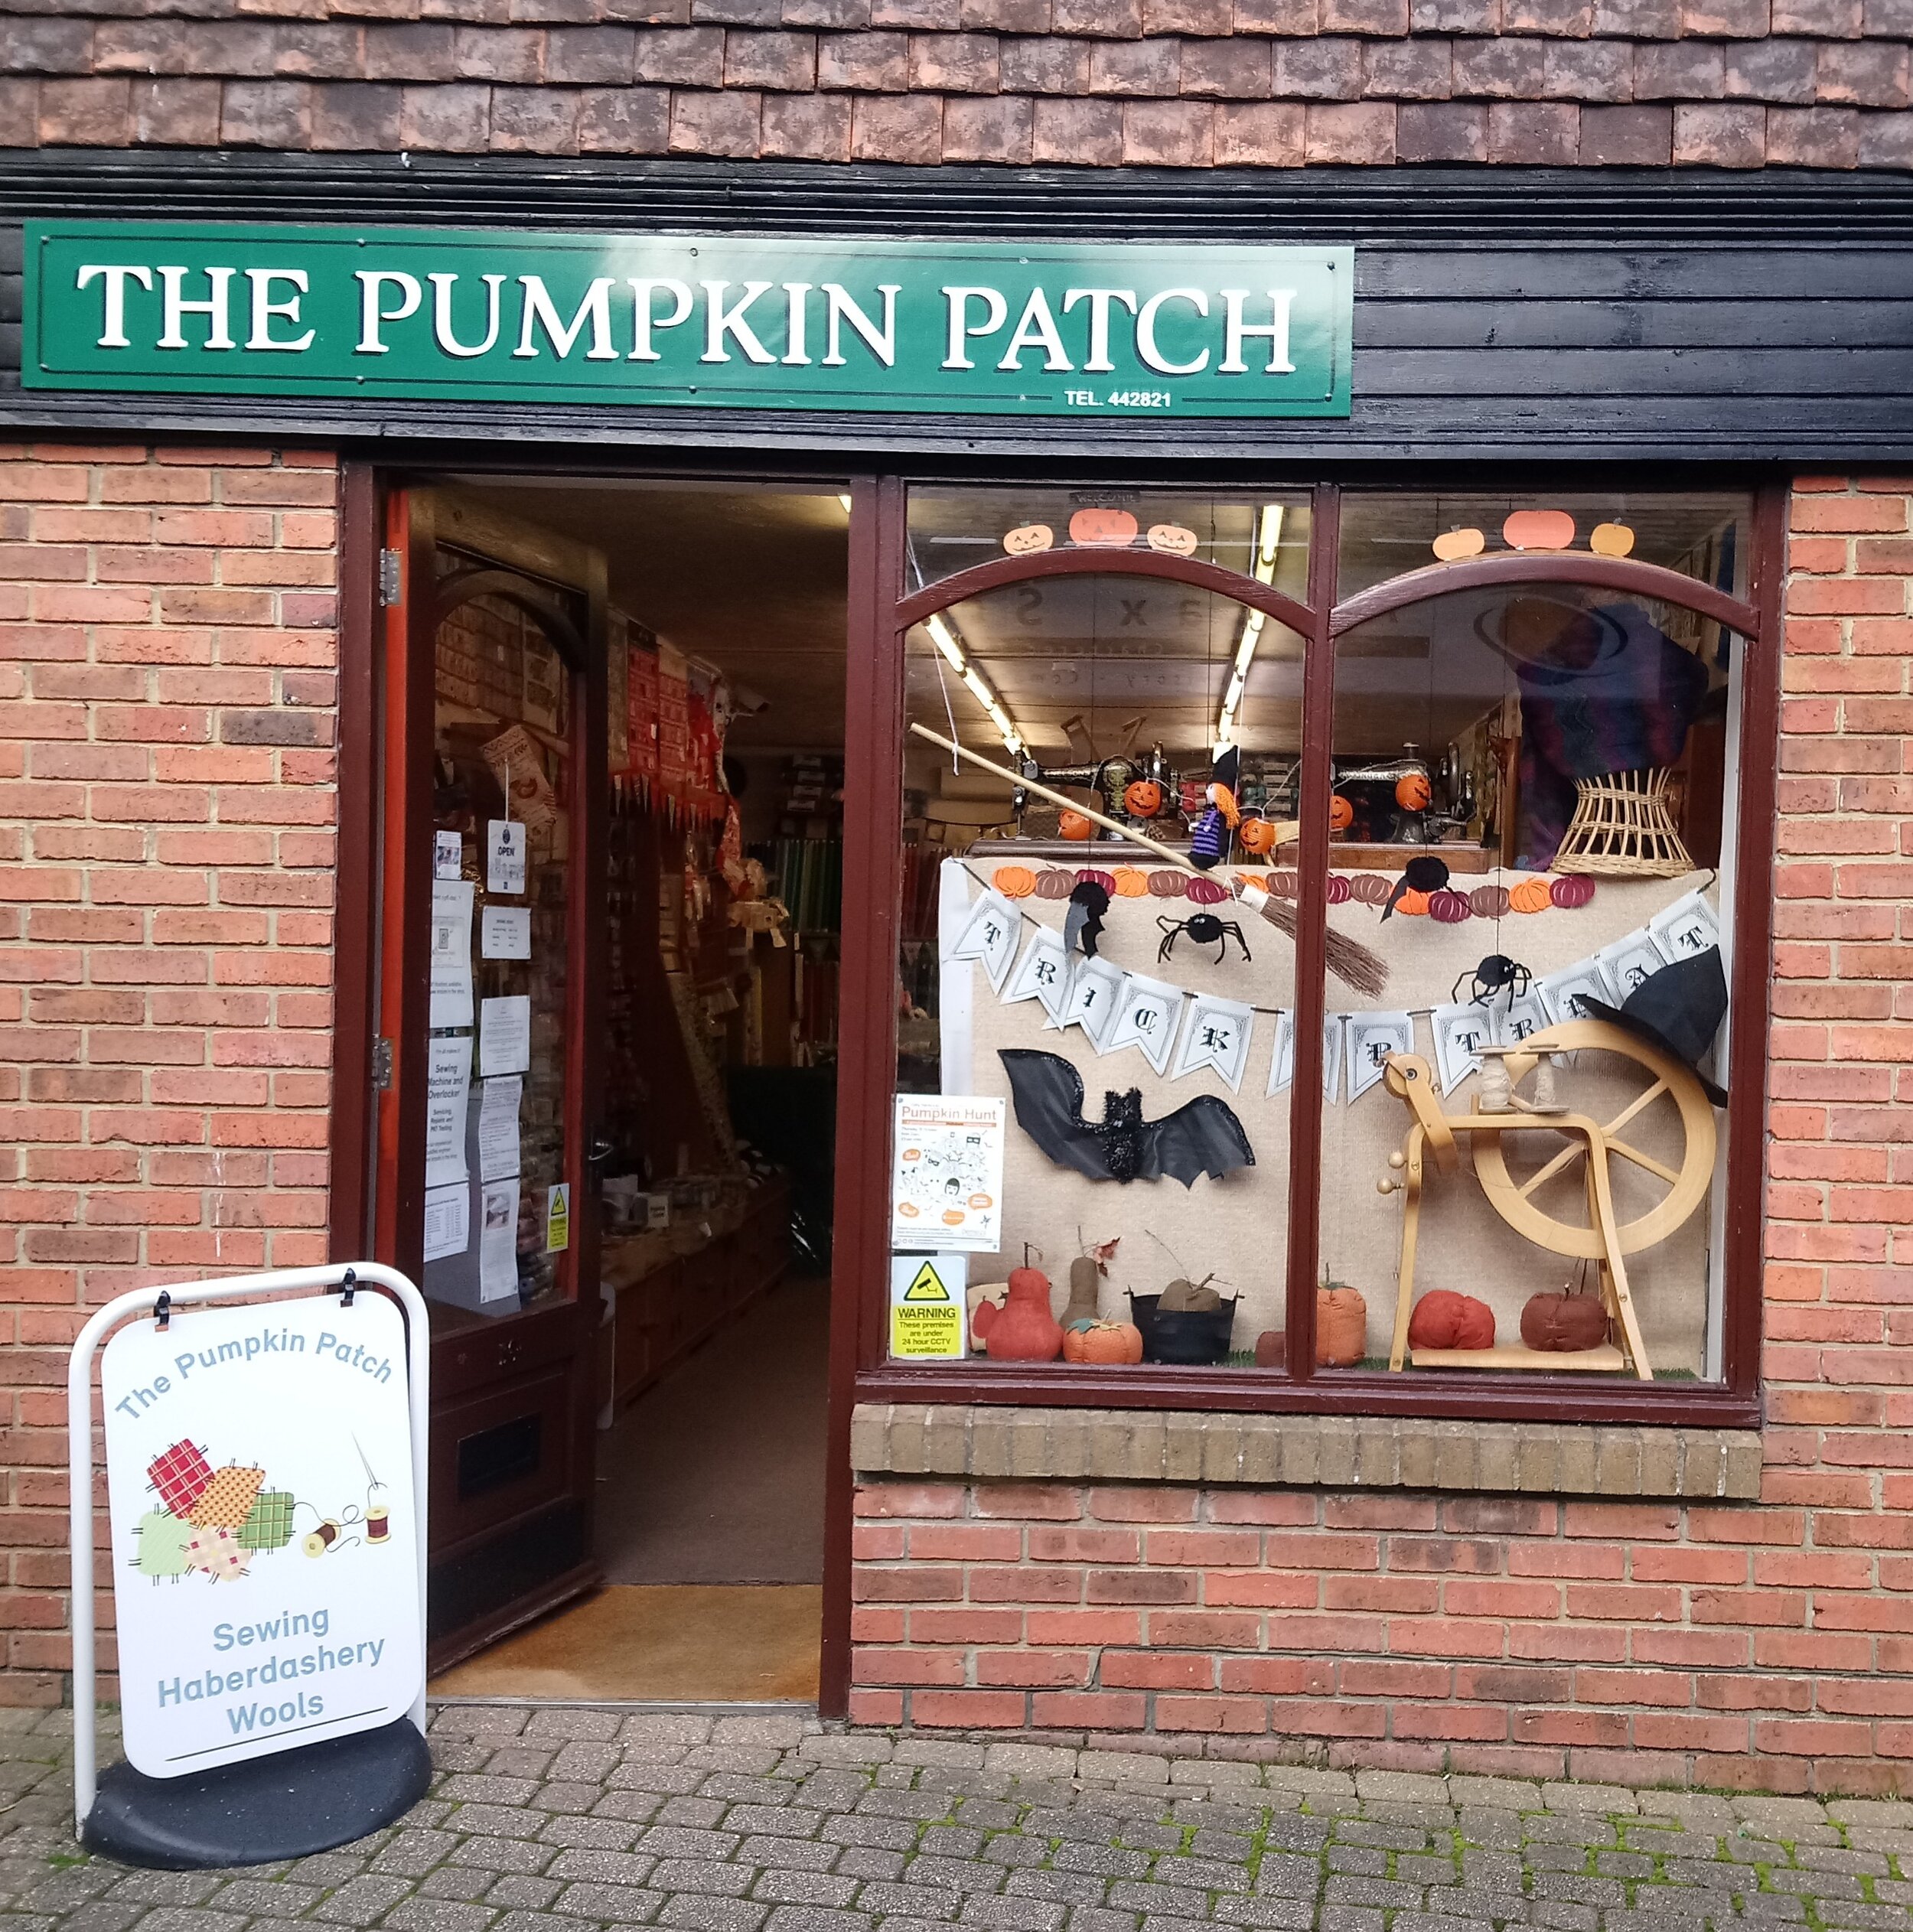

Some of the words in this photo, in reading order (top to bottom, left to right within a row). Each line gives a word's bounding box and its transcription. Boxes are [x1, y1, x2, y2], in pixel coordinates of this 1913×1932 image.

[77, 263, 316, 351] THE
[354, 269, 903, 368] PUMPKIN
[941, 285, 1299, 375] PATCH
[1064, 390, 1104, 406] TEL.
[1107, 391, 1172, 408] 442821
[497, 846, 515, 856] OPEN
[983, 921, 1231, 1054] TRICK
[435, 1064, 458, 1074] Sewing
[429, 1090, 461, 1100] Overlocker
[902, 1106, 960, 1122] Pumpkin
[966, 1109, 996, 1120] Hunt
[898, 1308, 956, 1318] WARNING
[114, 1376, 171, 1419] The
[174, 1328, 305, 1380] Pumpkin
[315, 1331, 393, 1384] Patch
[213, 1609, 329, 1652] Sewing
[158, 1637, 386, 1708] Haberdashery
[226, 1692, 324, 1735] Wools
